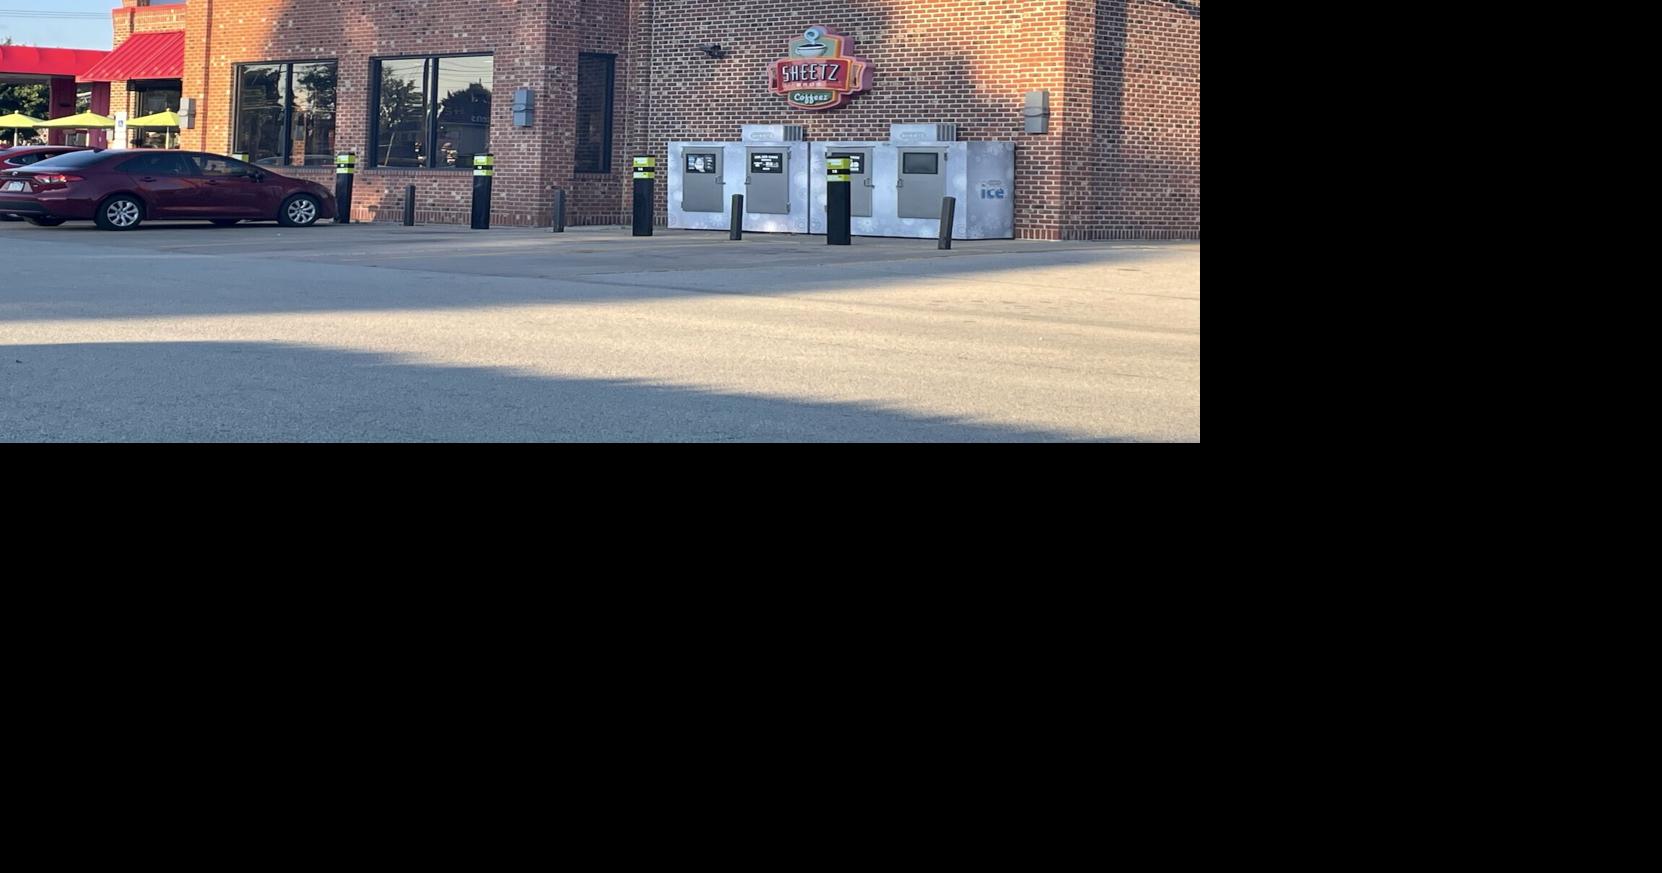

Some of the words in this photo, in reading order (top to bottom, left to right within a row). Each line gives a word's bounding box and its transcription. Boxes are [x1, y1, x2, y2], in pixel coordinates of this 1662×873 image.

[782, 63, 839, 82] SHEETZ
[794, 93, 829, 104] Coffeez
[981, 183, 1005, 199] ice
